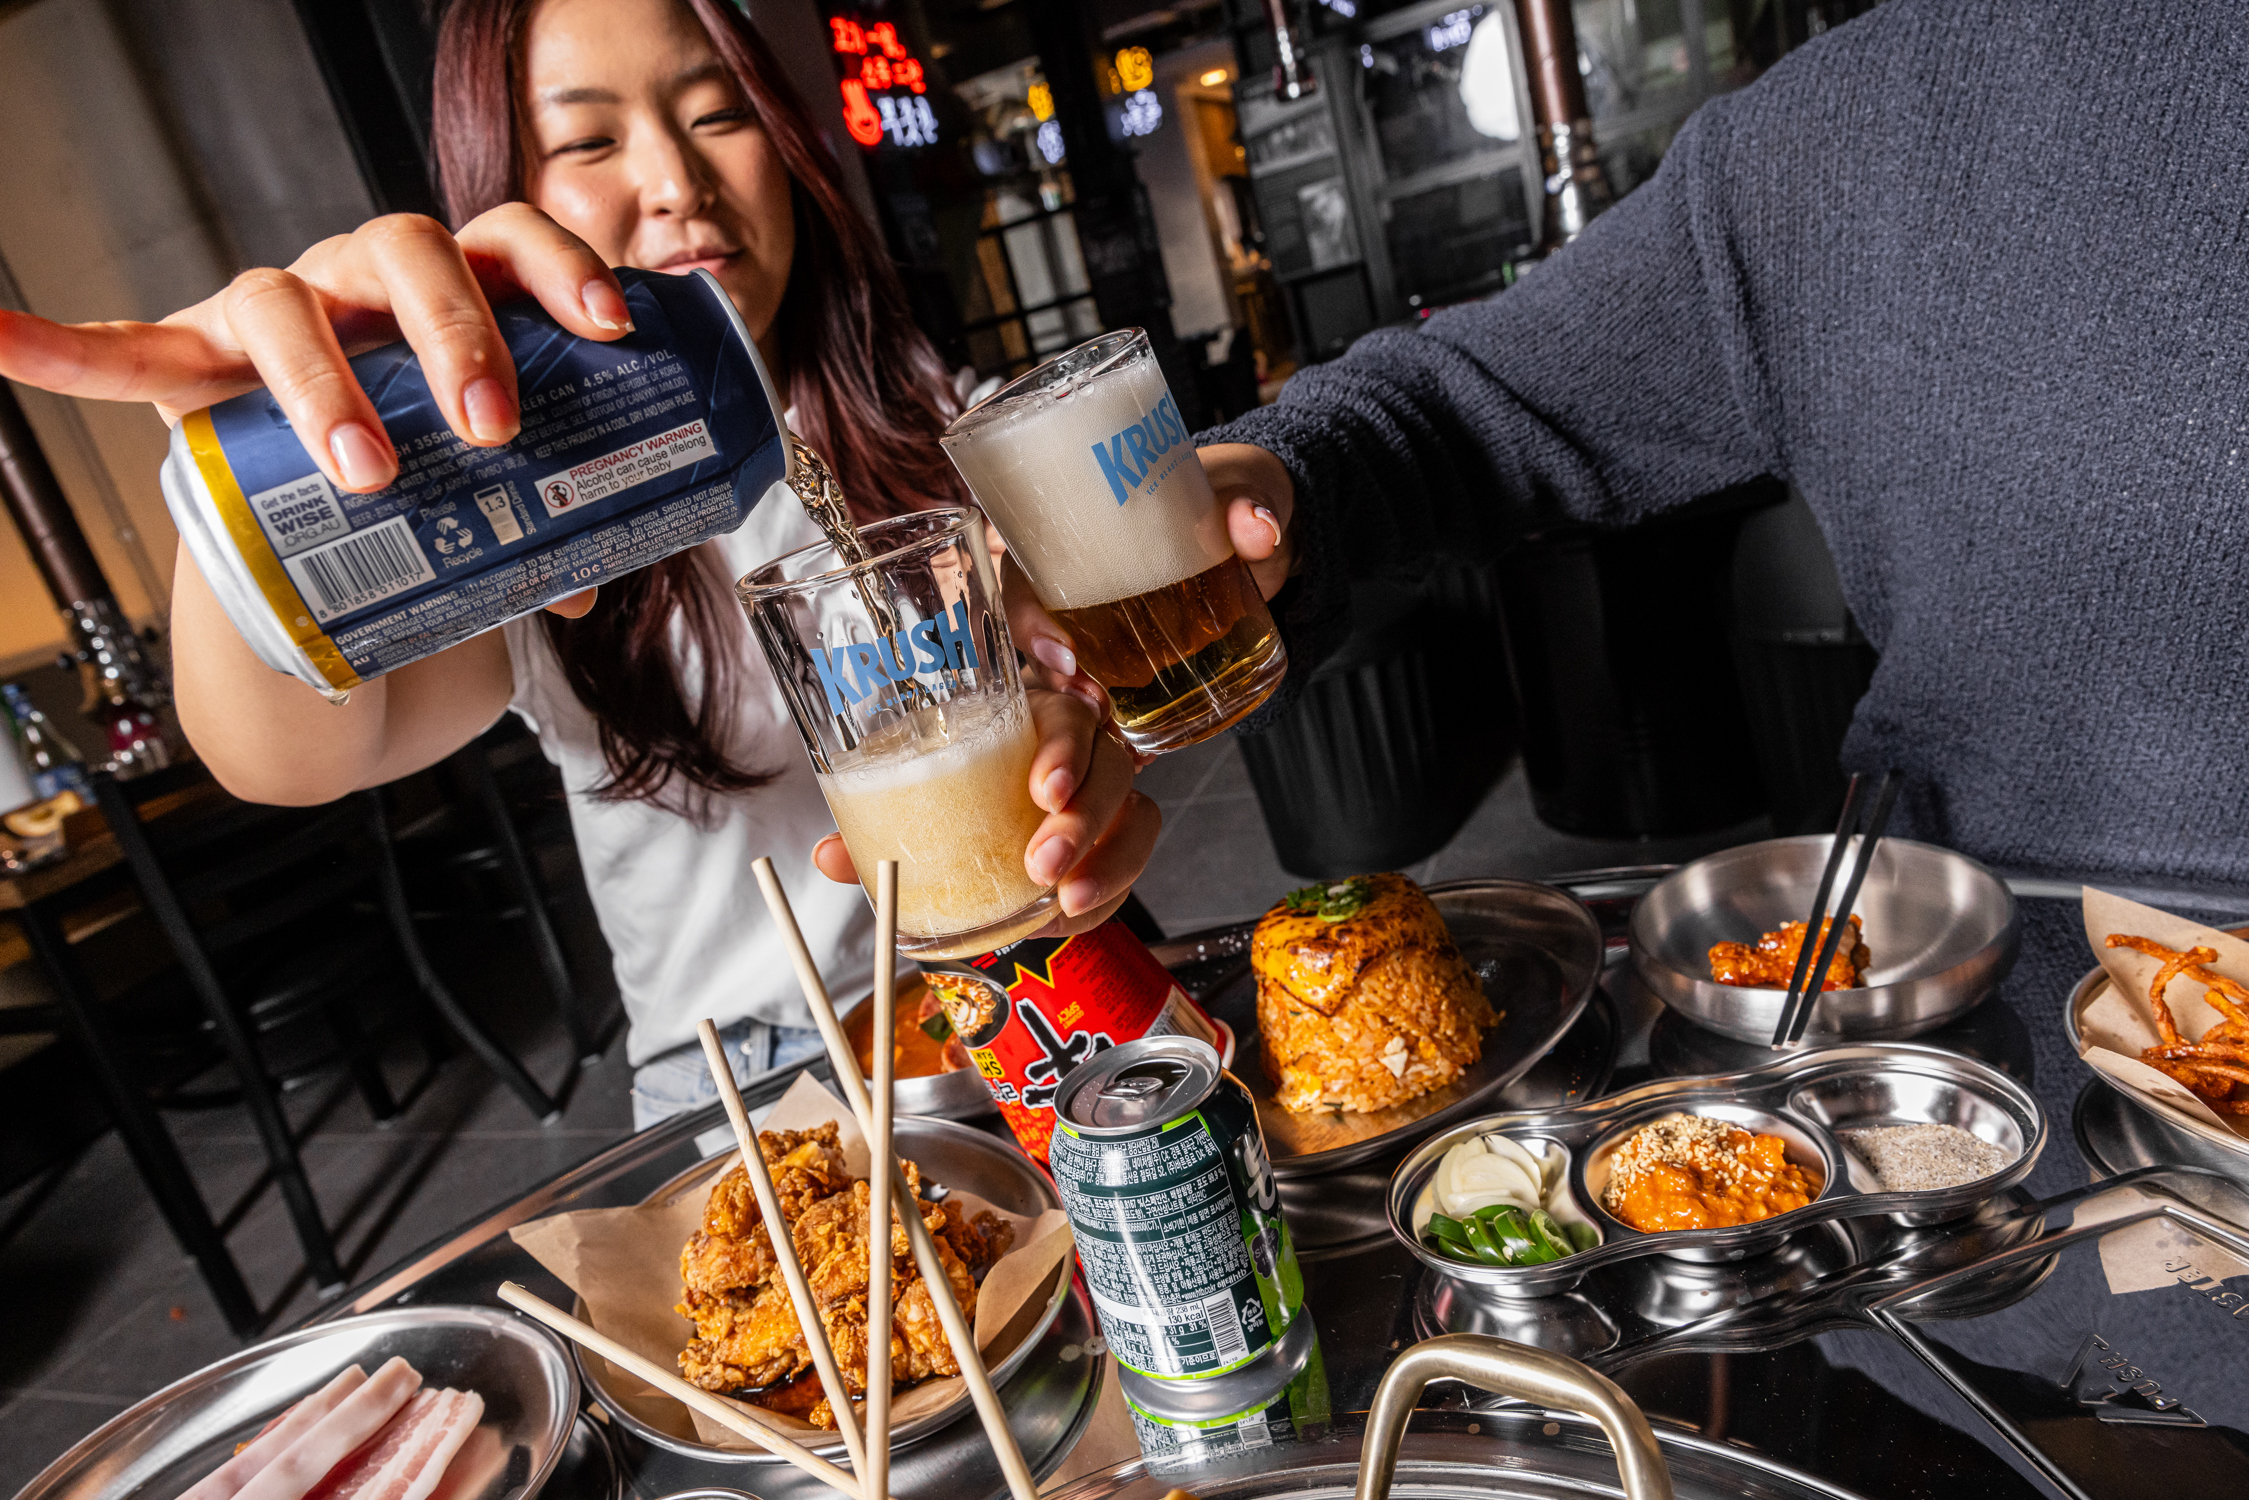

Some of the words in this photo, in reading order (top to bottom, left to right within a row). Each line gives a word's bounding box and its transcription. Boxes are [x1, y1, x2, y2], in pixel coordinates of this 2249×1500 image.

[549, 383, 575, 400] CAN
[583, 369, 614, 387] 4.5%
[616, 349, 676, 375] ALC./VOL.
[616, 373, 650, 392] REPUBLIC
[658, 362, 683, 377] KOREA
[568, 443, 643, 480] PREGNANCY
[645, 422, 702, 450] WARNING
[576, 468, 614, 492] Alcohol
[615, 462, 636, 476] can
[636, 449, 668, 468] cause
[668, 435, 707, 455] lifelong
[579, 485, 608, 501] harm
[608, 480, 620, 490] to
[620, 469, 647, 488] your
[645, 459, 671, 476] baby
[261, 497, 279, 510] Get
[279, 492, 296, 503] the
[296, 483, 321, 497] facts
[484, 495, 506, 512] 1.3
[268, 494, 327, 523] DRINK
[274, 505, 335, 535] WISE
[418, 501, 457, 521] Please
[442, 547, 483, 568] Recycle
[600, 549, 628, 564] REFUND
[629, 545, 637, 553] AT
[638, 529, 677, 549] COLLECTION
[335, 610, 407, 645] GOVERNMENT
[408, 590, 458, 615] WARNING
[464, 582, 478, 593] (1)
[479, 563, 526, 587] ACCORDING
[525, 558, 538, 569] TO
[536, 551, 554, 564] THE
[553, 537, 591, 558] SURGEON
[628, 509, 659, 527] WOMEN
[661, 496, 692, 515] SHOULD
[692, 489, 707, 502] NOT
[707, 479, 732, 496] DRINK
[382, 613, 425, 636] BEVERAGES
[424, 602, 454, 619] DURING
[453, 585, 495, 607] PREGNANCY
[495, 571, 528, 590] BECAUSE
[528, 567, 538, 577] OF
[538, 561, 553, 572] THE
[552, 555, 570, 567] RISK
[569, 550, 579, 561] OF
[579, 542, 601, 556] BIRTH
[631, 526, 643, 537] (2)
[643, 507, 690, 531] CONSUMPTION
[690, 502, 699, 513] OF
[700, 489, 733, 508] ALCOHOLIC
[603, 548, 647, 570] PARTICIPATING
[390, 623, 424, 640] IMPAIRS
[423, 614, 444, 628] YOUR
[445, 603, 471, 619] ABILITY
[472, 598, 483, 608] TO
[482, 590, 505, 604] DRIVE
[512, 581, 528, 592] CAR
[528, 576, 540, 586] OR
[539, 563, 571, 581] OPERATE
[615, 539, 630, 551] AND
[630, 532, 646, 544] MAY
[646, 523, 670, 538] CAUSE
[670, 512, 696, 528] HEALTH
[352, 655, 370, 666] AU
[810, 600, 980, 717] KRUSH
[1056, 1001, 1082, 1024] SPICY
[1195, 1176, 1208, 1189] 포도
[1162, 1217, 1185, 1233] 소비기한
[1186, 1212, 1199, 1224] 제품
[1182, 1228, 1201, 1243] 후에는
[1199, 1220, 1218, 1237] 반드시
[1184, 1267, 1191, 1277] 수
[1190, 1259, 1214, 1276] 있습니다
[1207, 1266, 1224, 1280] 사용한
[1167, 1314, 1182, 1326] 130
[1183, 1308, 1204, 1321] kcal
[1174, 1304, 1188, 1314] 238
[1168, 1324, 1177, 1335] 31
[1188, 1320, 1197, 1331] 31
[1180, 1349, 1216, 1365] 기준이므로
[2099, 1350, 2181, 1413] PUSH
